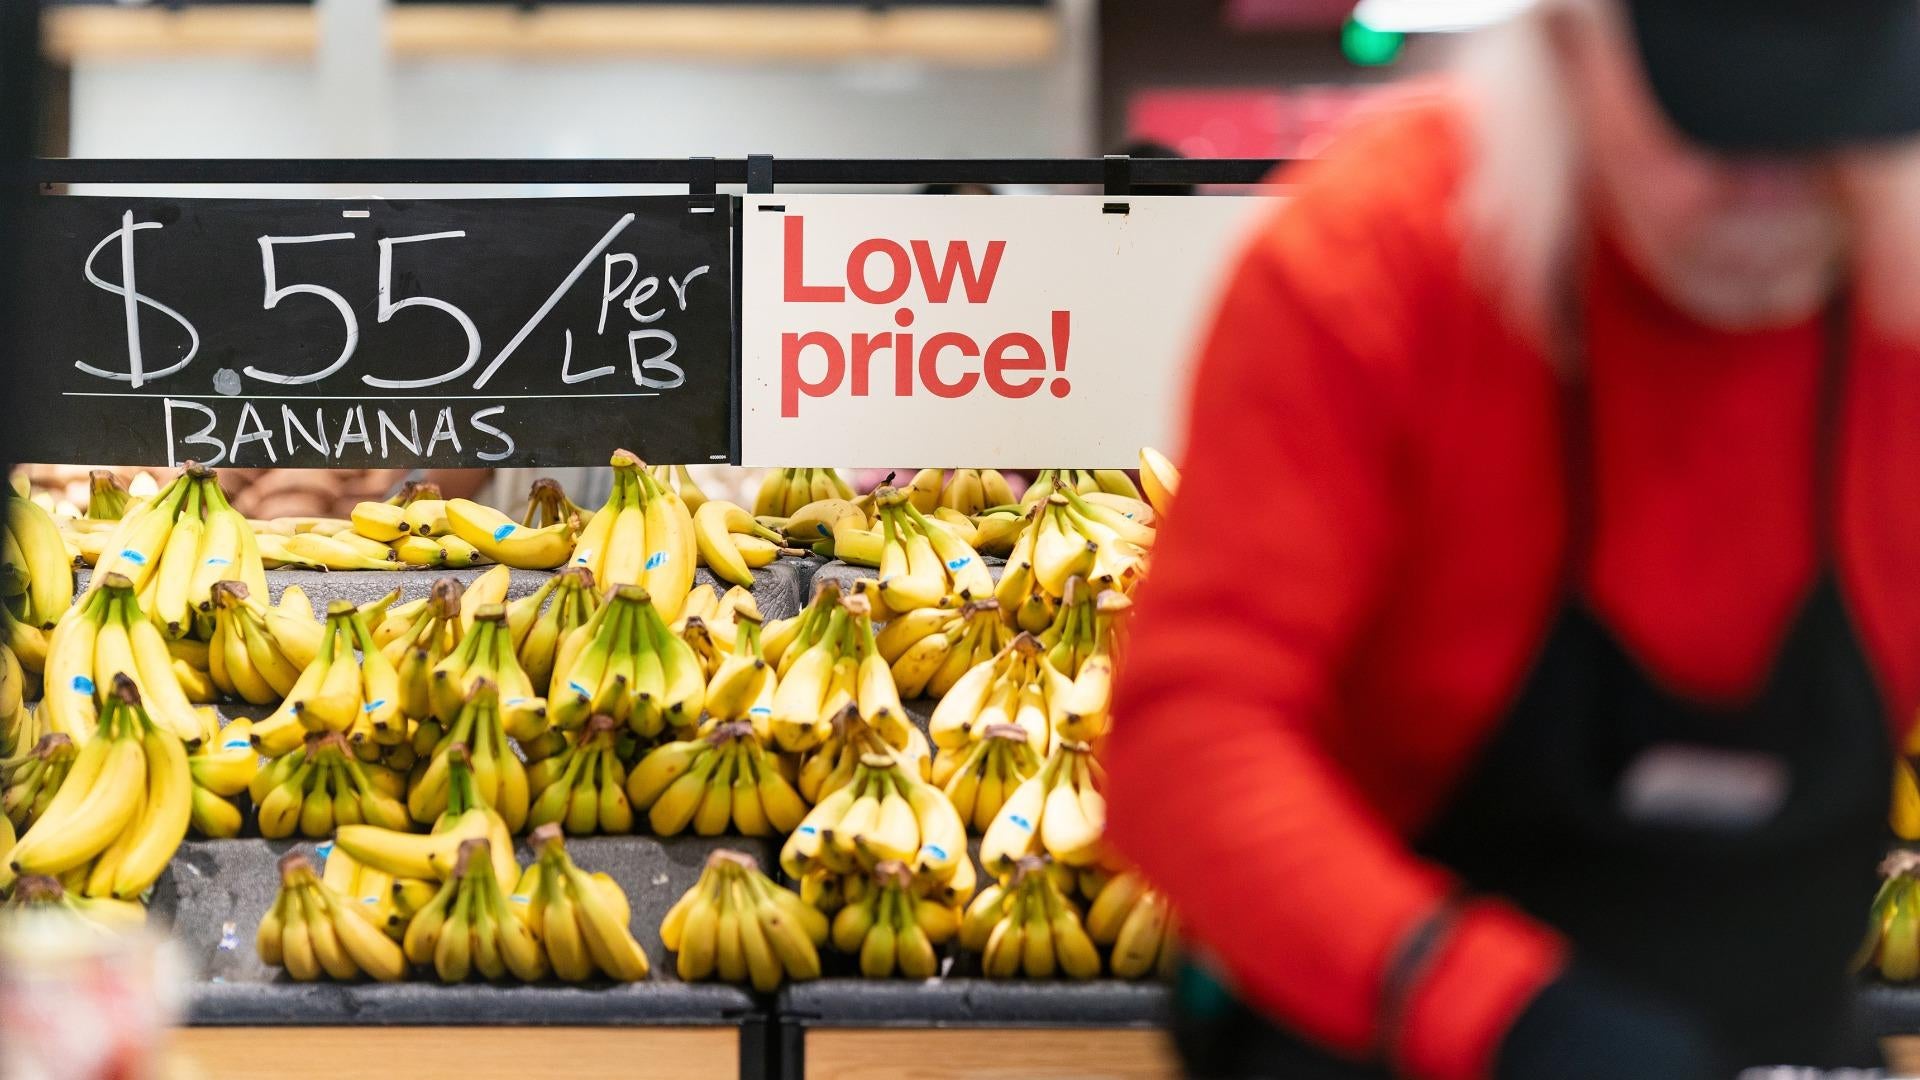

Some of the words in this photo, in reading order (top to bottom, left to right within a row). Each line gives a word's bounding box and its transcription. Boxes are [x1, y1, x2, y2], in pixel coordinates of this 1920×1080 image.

[598, 252, 710, 335] Per
[784, 215, 1007, 304] Low
[561, 328, 686, 389] LB
[781, 307, 1072, 418] price!
[164, 398, 515, 468] BANANAS
